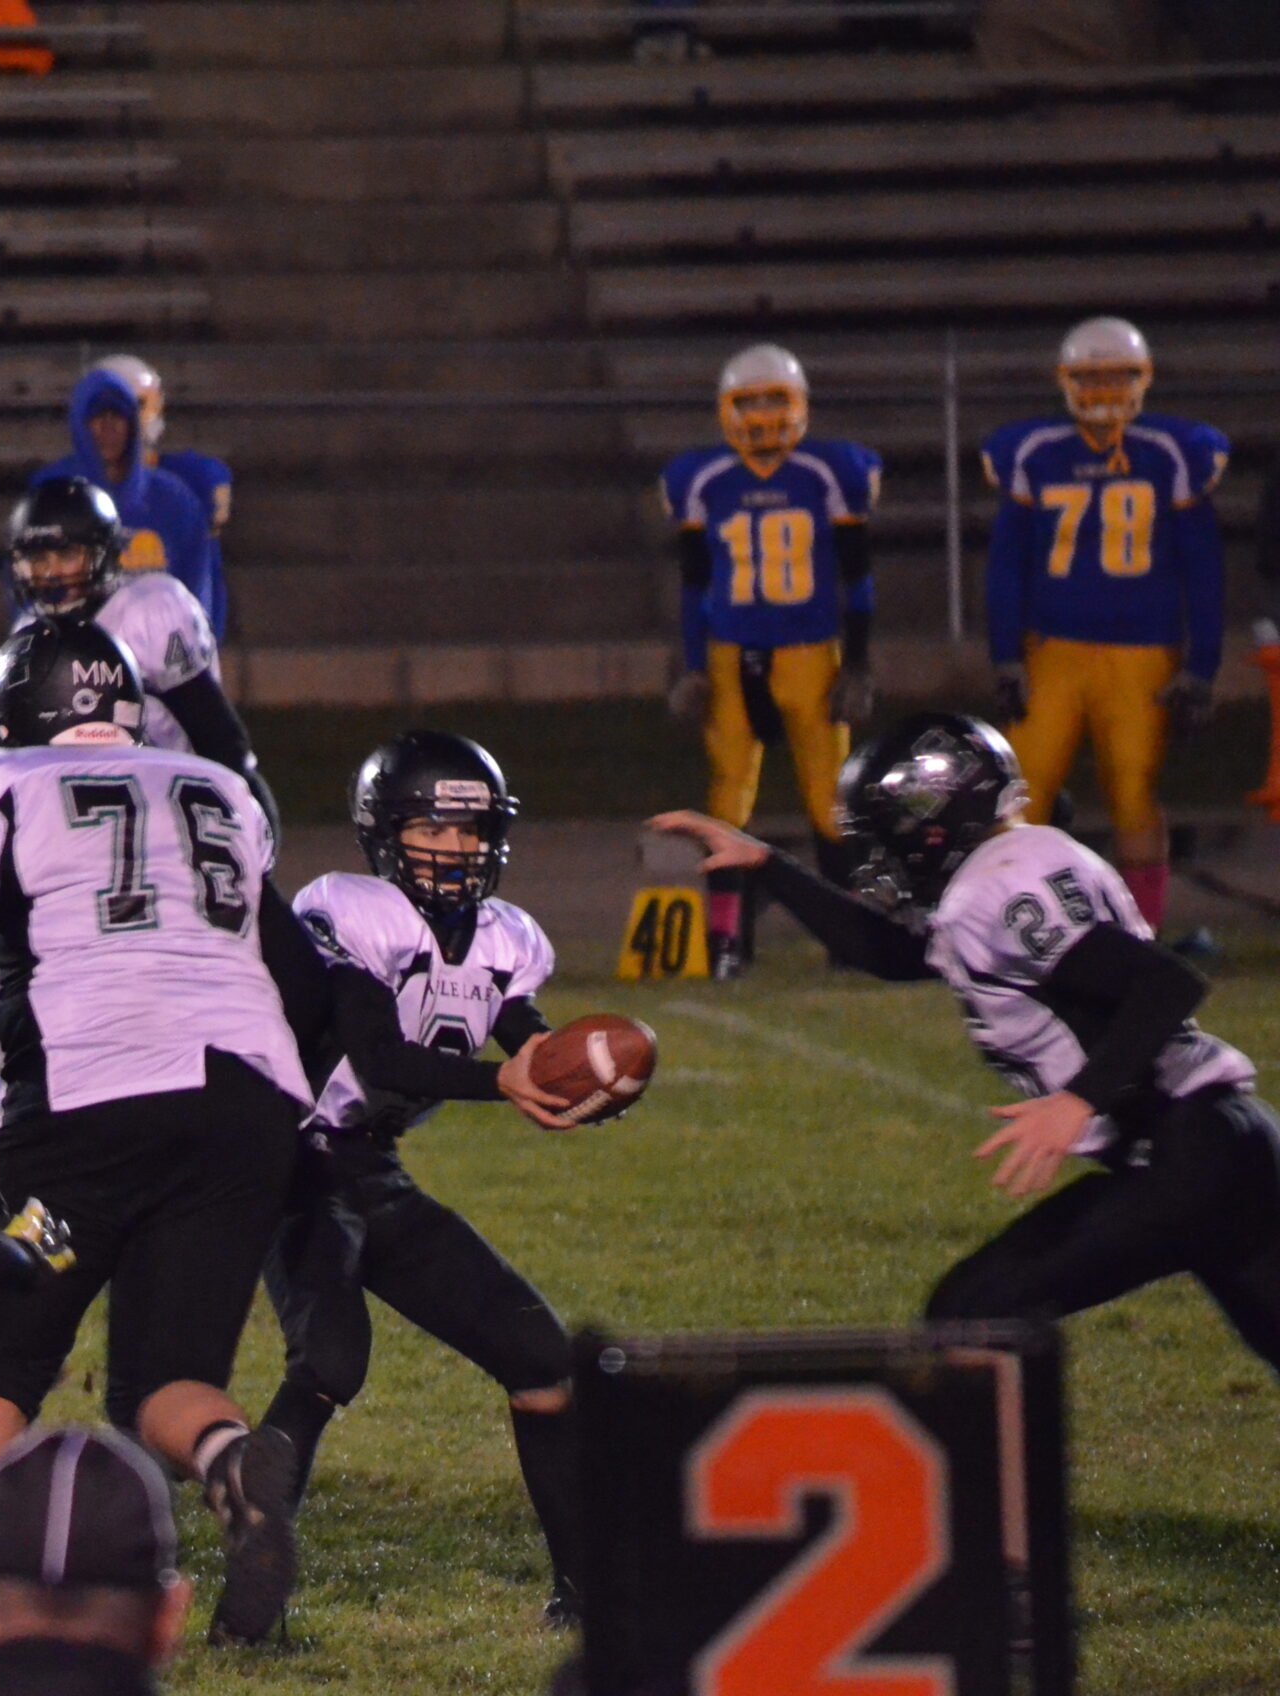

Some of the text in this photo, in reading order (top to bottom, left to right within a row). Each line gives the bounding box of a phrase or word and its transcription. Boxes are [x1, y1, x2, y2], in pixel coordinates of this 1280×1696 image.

[718, 508, 815, 606] 18
[1040, 479, 1156, 578] 78
[71, 659, 124, 688] MM
[59, 774, 251, 939] 76
[631, 897, 694, 973] 40
[1004, 866, 1095, 962] 25
[683, 1383, 956, 1696] 2
